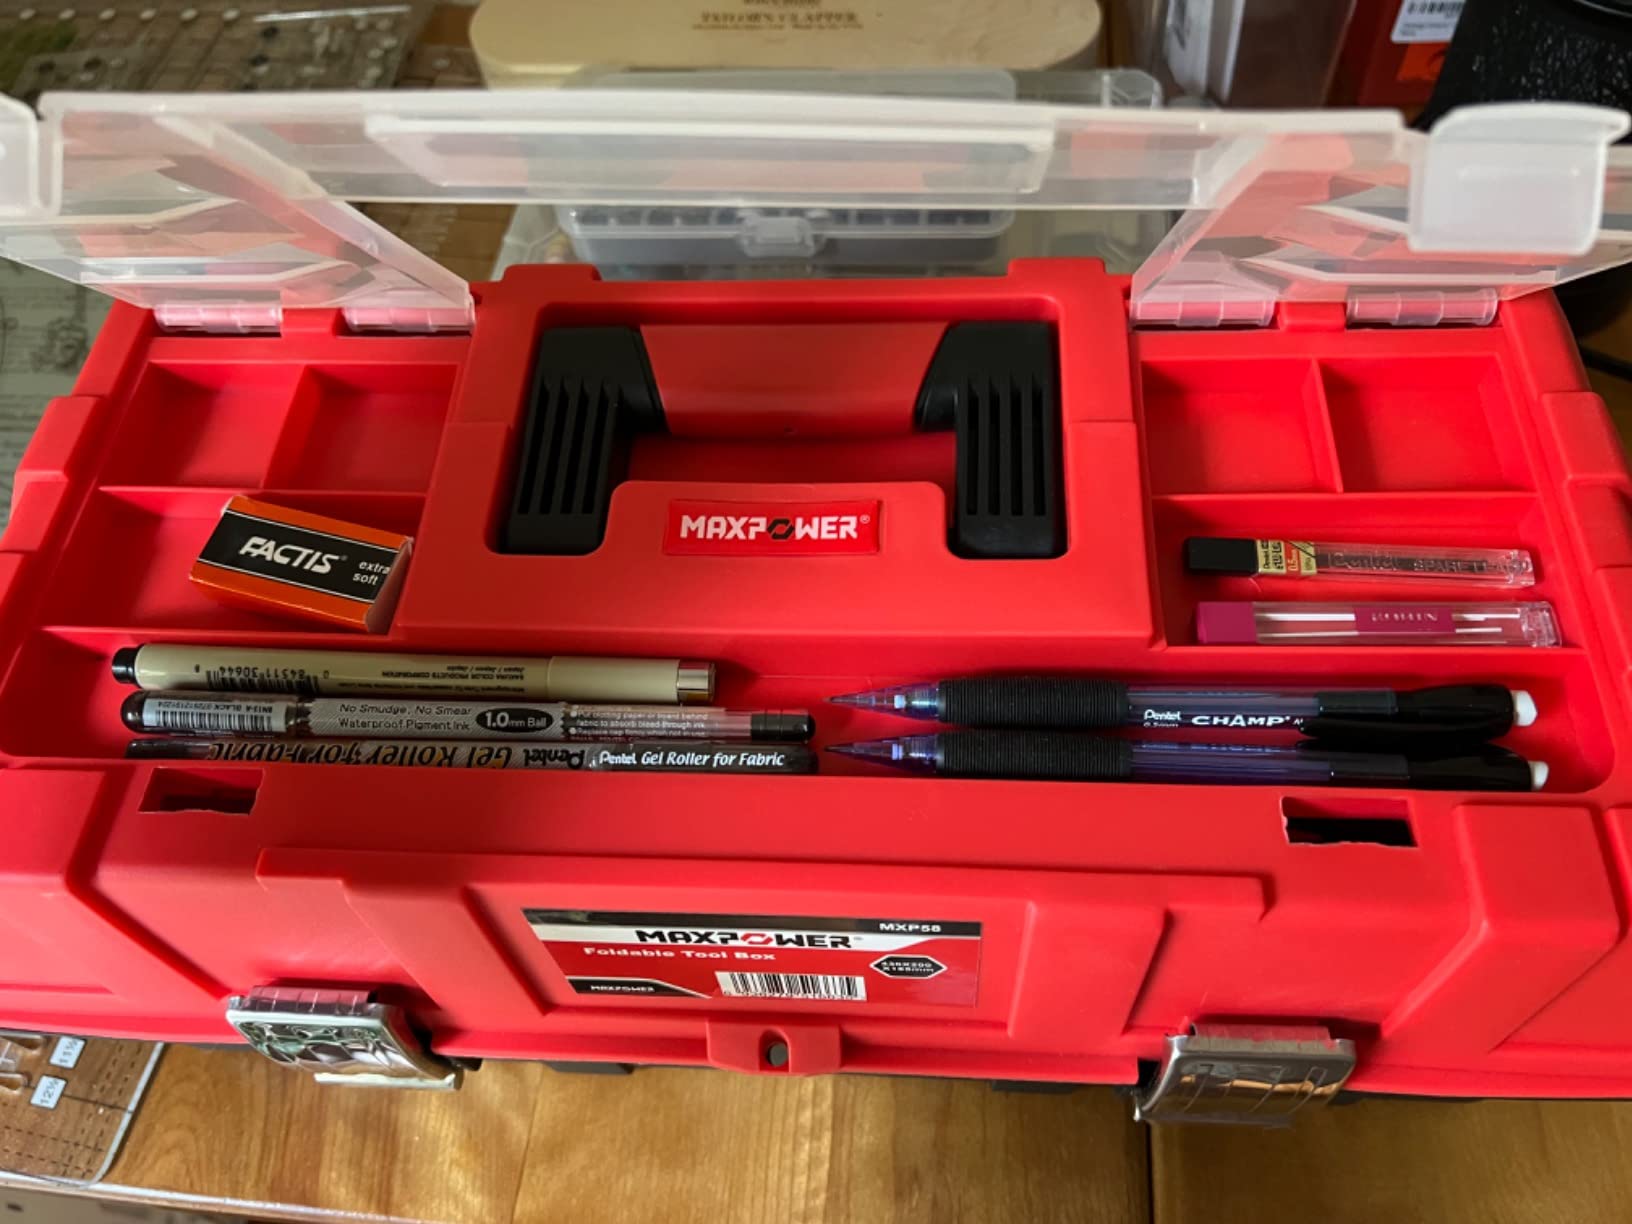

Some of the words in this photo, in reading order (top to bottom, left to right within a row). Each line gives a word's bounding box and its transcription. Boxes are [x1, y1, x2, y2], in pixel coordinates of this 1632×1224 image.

[358, 560, 392, 576] extra
[352, 572, 379, 586] soft
[339, 703, 356, 714] No
[414, 705, 433, 715] No
[434, 705, 472, 716] Smear
[1143, 708, 1182, 721] Pentel
[338, 717, 404, 730] Waterproof
[405, 719, 451, 731] Pigment
[453, 721, 471, 731] Ink
[526, 716, 547, 728] Ball
[523, 748, 585, 770] Pentel
[599, 750, 637, 766] Pentel
[641, 751, 664, 766] Gel
[666, 751, 710, 767] Roller
[712, 752, 736, 768] for
[738, 751, 785, 767] Fabric
[583, 947, 676, 958] Foldable
[680, 950, 728, 959] Tool
[734, 952, 776, 960] Box
